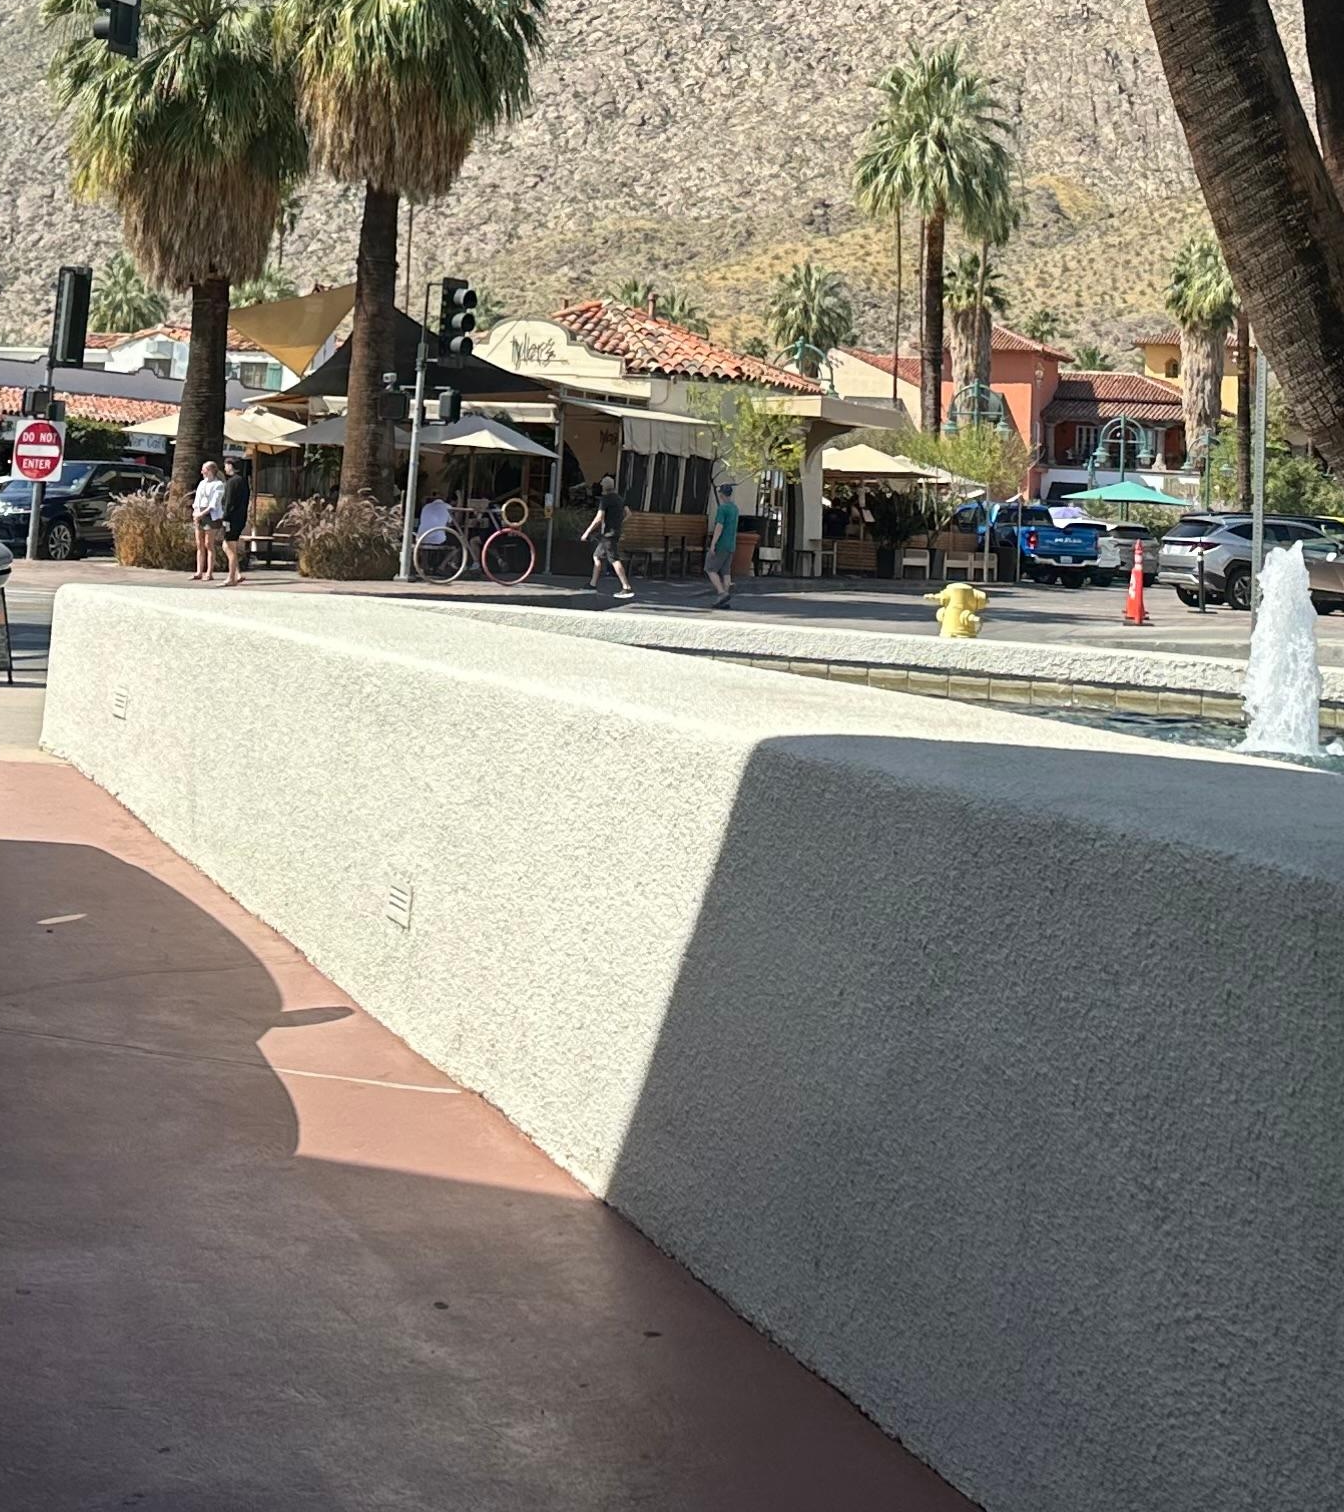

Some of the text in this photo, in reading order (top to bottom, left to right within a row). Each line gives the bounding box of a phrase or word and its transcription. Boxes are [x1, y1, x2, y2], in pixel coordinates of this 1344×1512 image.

[22, 432, 58, 444] DO NOT
[22, 458, 52, 470] ENTER
